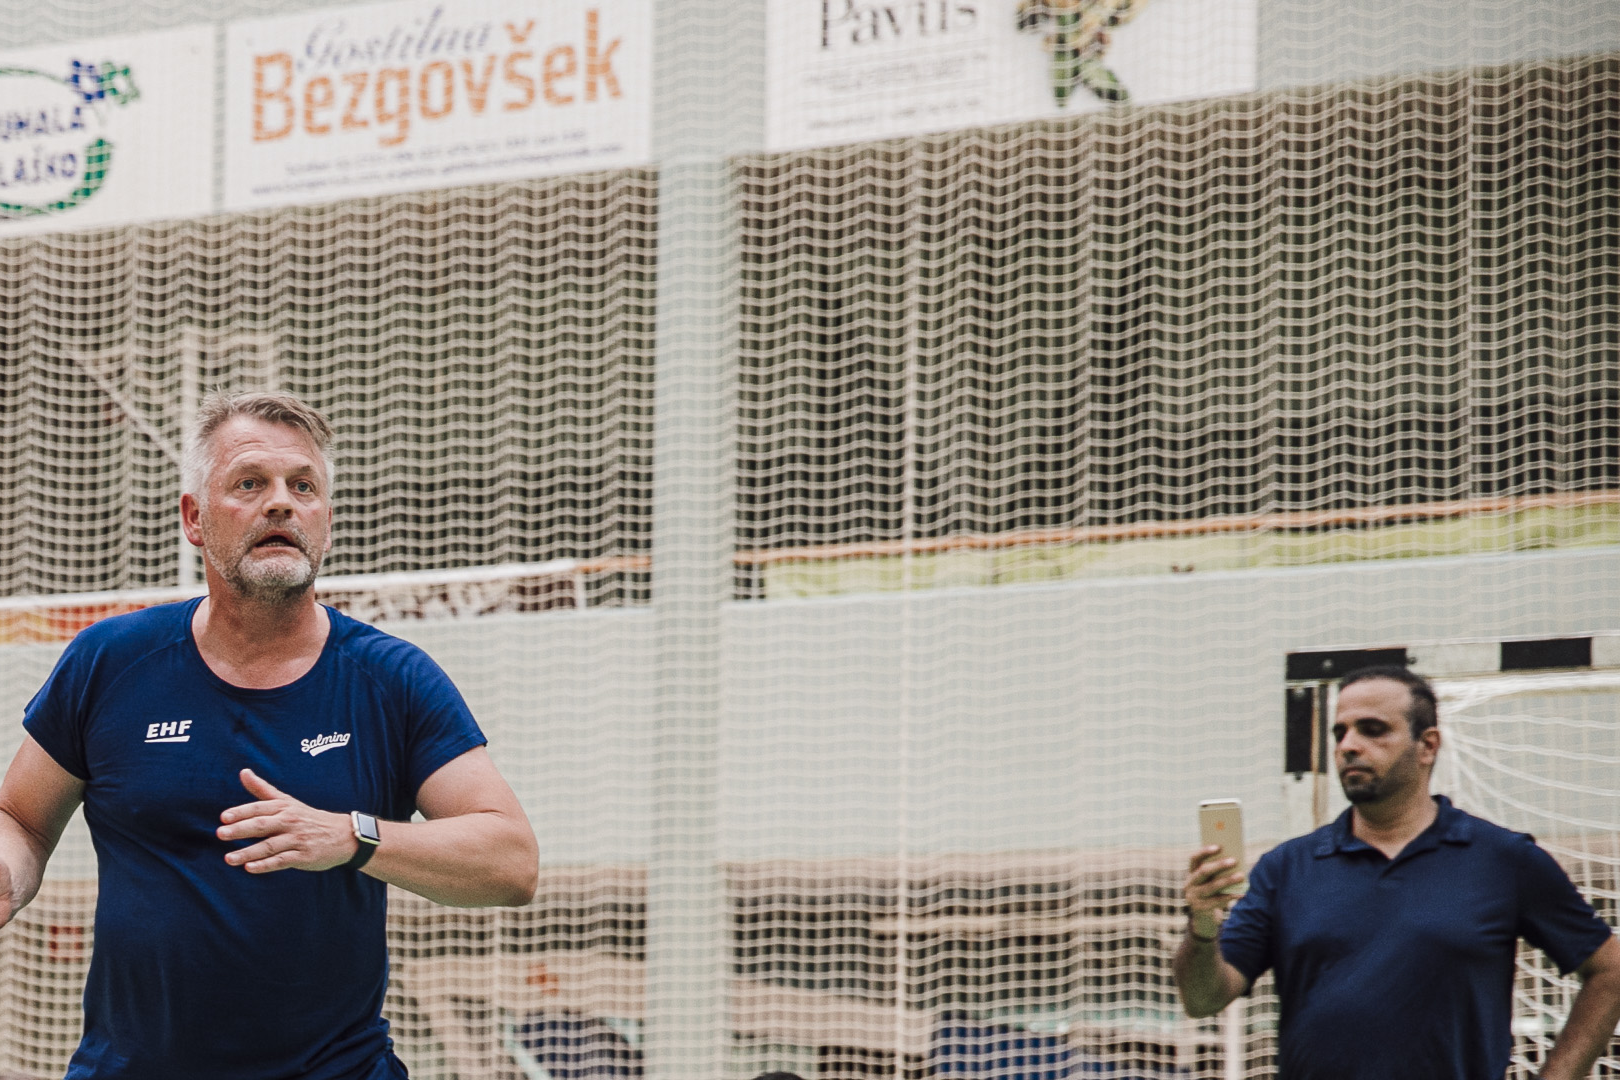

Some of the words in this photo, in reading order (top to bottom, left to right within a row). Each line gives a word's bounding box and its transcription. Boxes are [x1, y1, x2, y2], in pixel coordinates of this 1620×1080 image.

[252, 8, 623, 147] Bezgovšek
[145, 719, 193, 739] EHF
[300, 731, 352, 754] Salming
